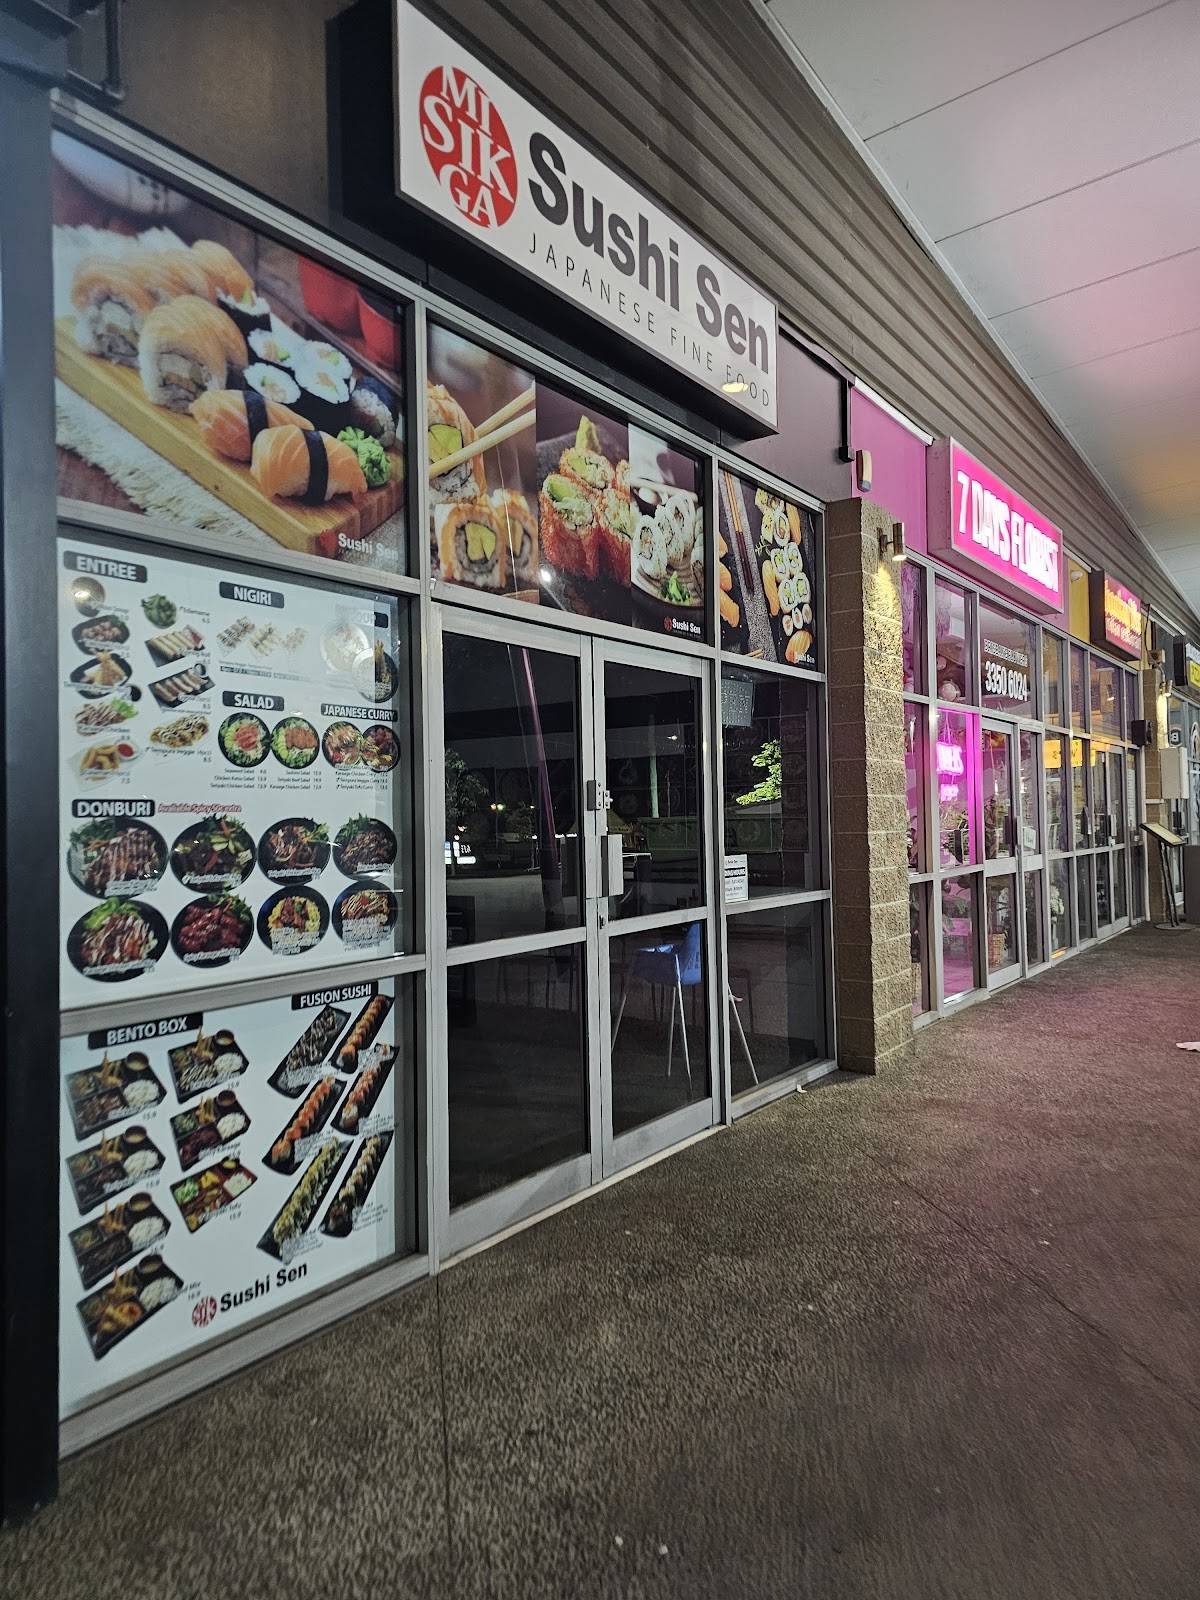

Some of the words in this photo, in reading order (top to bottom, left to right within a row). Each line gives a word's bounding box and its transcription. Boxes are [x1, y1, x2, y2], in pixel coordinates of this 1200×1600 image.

[441, 65, 493, 137] MI
[423, 95, 514, 203] SIK
[439, 163, 496, 229] GA
[528, 132, 681, 312] Sushi
[696, 264, 770, 375] Sen
[529, 233, 656, 334] JAPANESE
[670, 327, 714, 373] FINE
[726, 364, 771, 408] FOOD
[338, 532, 373, 555] Sushi
[376, 542, 399, 561] Sen
[957, 471, 970, 534] 7
[971, 480, 1010, 563] DAYS
[1010, 510, 1060, 593] FLORIST
[76, 555, 137, 580] ENTREE
[233, 585, 272, 606] NIGIRI
[672, 618, 689, 632] Sushi
[986, 661, 1007, 696] 3350
[1008, 669, 1028, 702] 6024
[233, 693, 275, 710] SALAD
[323, 706, 366, 720] JAPANESE
[368, 710, 395, 721] CURRY
[77, 801, 152, 817] DONBURI
[300, 989, 339, 1008] FUSION
[341, 983, 373, 1001] SUSHI
[106, 1021, 157, 1045] BENTO
[158, 1016, 188, 1035] BOX
[219, 1276, 271, 1313] Sushi
[276, 1263, 308, 1288] Sen
